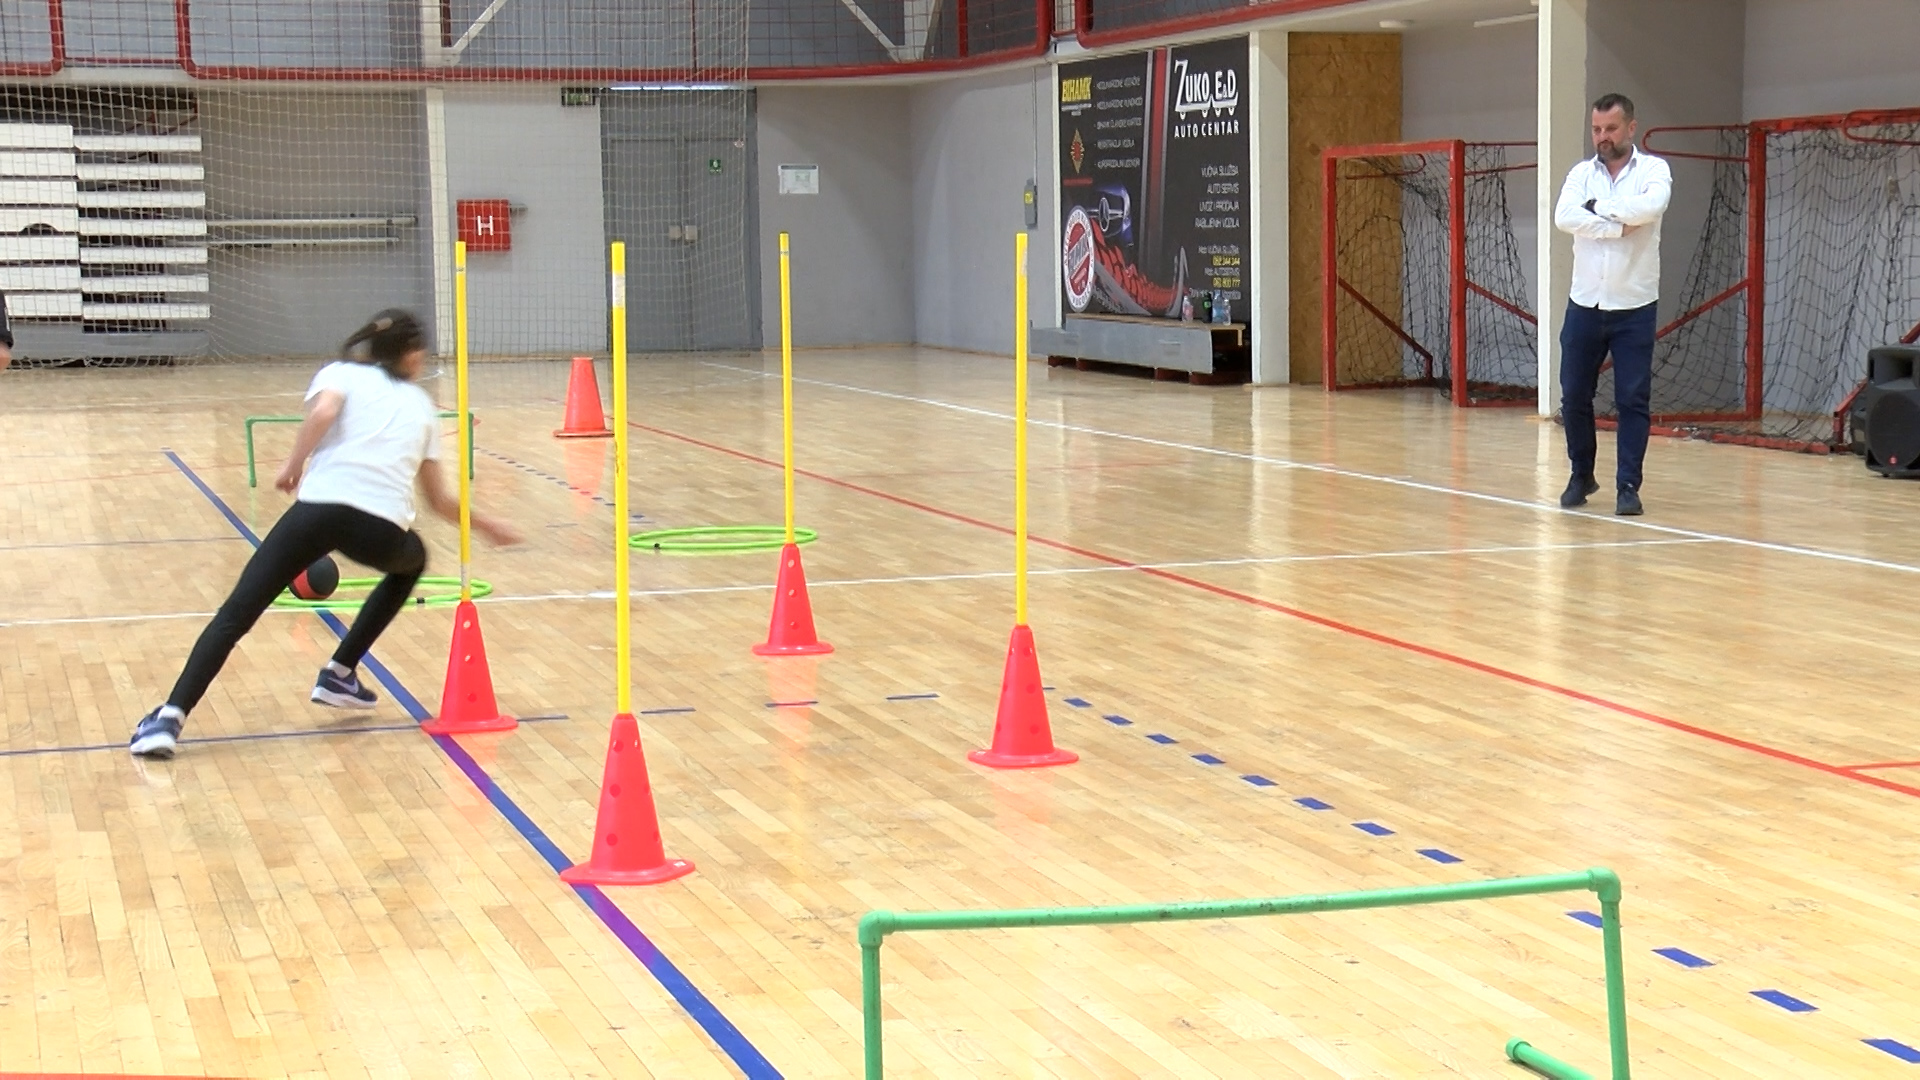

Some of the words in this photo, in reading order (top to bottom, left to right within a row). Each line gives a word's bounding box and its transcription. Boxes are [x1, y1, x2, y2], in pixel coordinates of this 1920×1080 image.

[1174, 59, 1210, 111] ZUKO
[1174, 123, 1199, 138] AUTO
[1201, 119, 1239, 137] CENTAR
[477, 215, 494, 236] H
